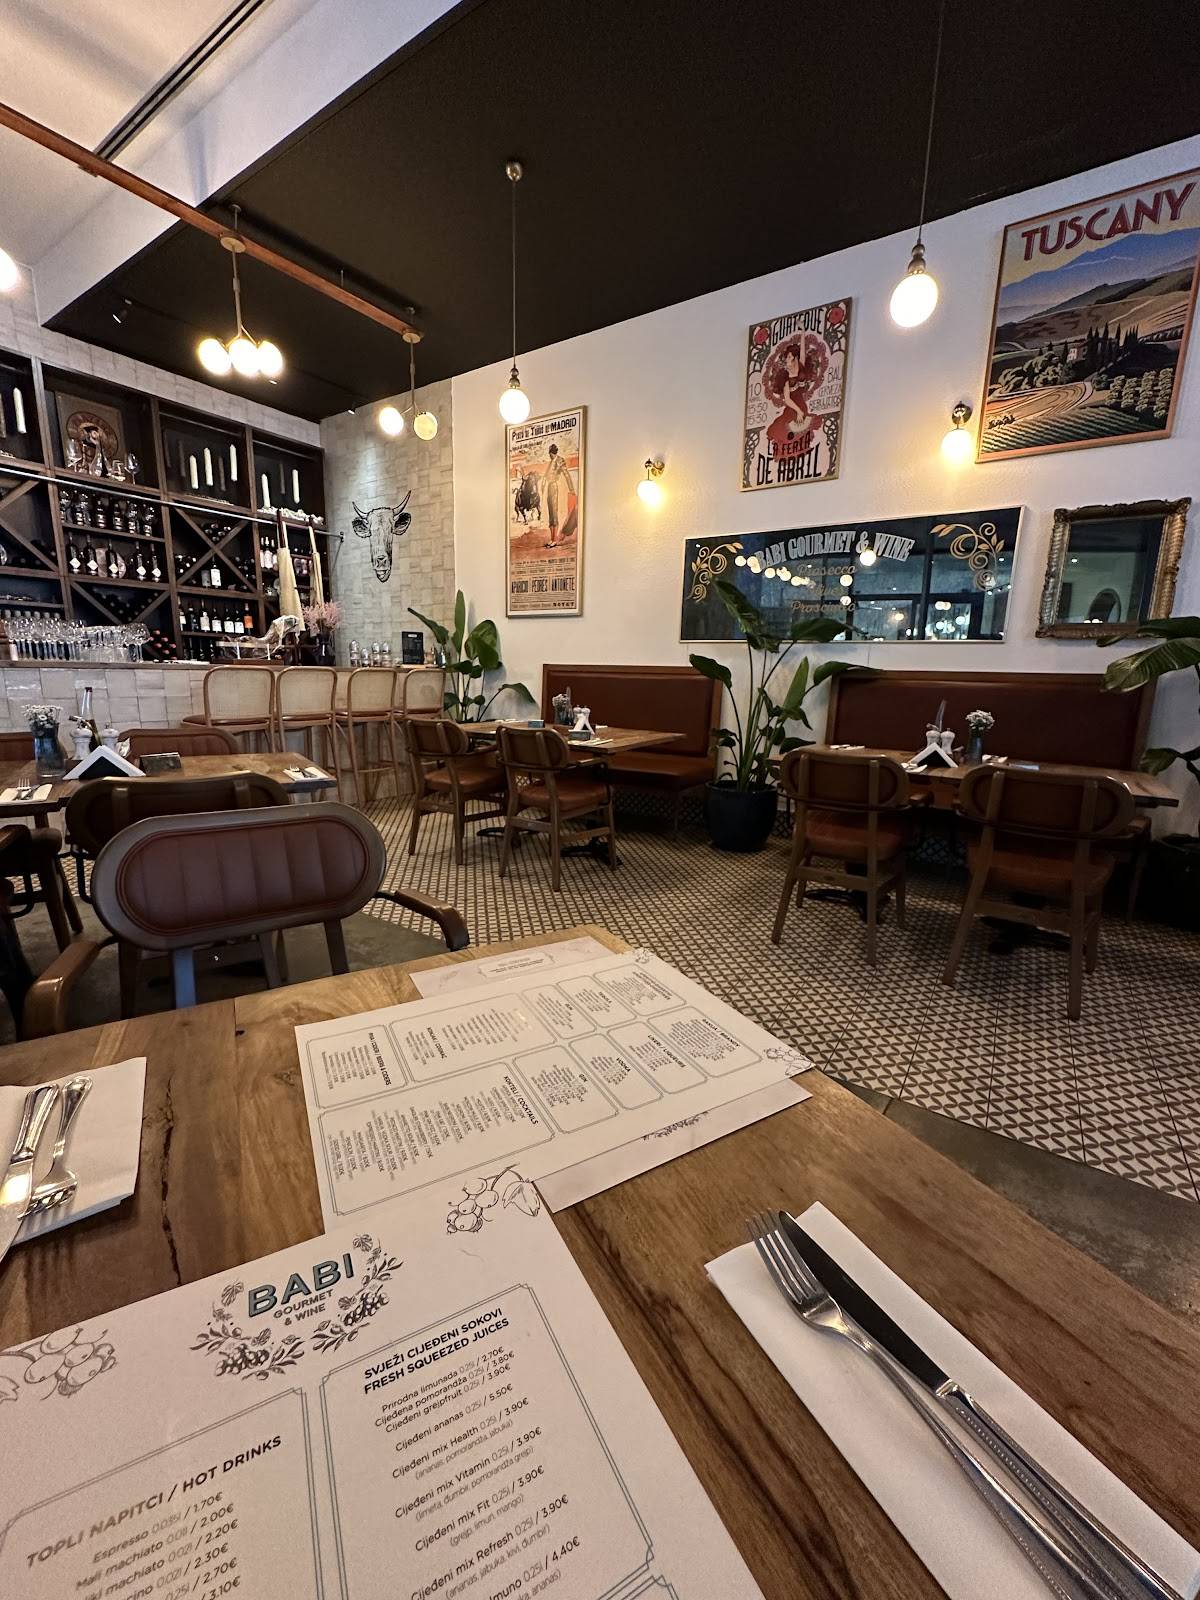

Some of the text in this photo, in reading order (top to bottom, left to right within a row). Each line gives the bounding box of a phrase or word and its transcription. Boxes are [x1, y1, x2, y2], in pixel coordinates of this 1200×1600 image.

[1022, 182, 1197, 261] TUSCANY
[550, 417, 577, 431] MADRID
[767, 431, 811, 457] LA FERIA
[757, 442, 822, 485] DE ABRIL
[755, 530, 915, 569] BABI GOURMET & WINE
[503, 1075, 520, 1095] KOKTELI
[517, 1096, 540, 1126] COCKTAILS
[248, 1253, 354, 1318] BABI
[273, 1289, 334, 1319] GOURMET
[284, 1303, 326, 1326] & WINE
[364, 1318, 509, 1394] FRESH SQUEEZED JUICES
[365, 1308, 502, 1379] SVJEŽI CIJEĐENI SOKOVI
[382, 1391, 418, 1413] Prirodna
[421, 1371, 458, 1393] limunada
[477, 1357, 481, 1367] /
[415, 1377, 467, 1408] pomorandža
[487, 1362, 489, 1372] /
[423, 1389, 462, 1415] grejpfruit
[482, 1375, 485, 1384] /
[434, 1411, 463, 1431] ananas
[482, 1395, 486, 1407] /
[489, 1384, 512, 1401] 5.50€
[432, 1443, 448, 1457] mix
[450, 1427, 478, 1447] Health
[499, 1411, 501, 1422] /
[504, 1398, 528, 1416] 3.90€
[437, 1480, 454, 1495] mix
[455, 1458, 490, 1482] Vitamin
[511, 1440, 514, 1453] /
[516, 1427, 541, 1447] 3.90€
[27, 1436, 281, 1568] TOPLI NAPITCI / HOT DRINKS
[92, 1530, 149, 1564] Espresso
[183, 1506, 191, 1520] /
[194, 1492, 222, 1512] 1.70€
[415, 1520, 455, 1551] Cijeđeni
[458, 1509, 475, 1526] mix
[477, 1499, 490, 1513] Fit
[512, 1481, 515, 1494] /
[517, 1465, 544, 1487] 3.90€
[105, 1540, 163, 1577] machiato
[190, 1520, 198, 1536] /
[200, 1503, 233, 1528] 2.00€
[105, 1559, 165, 1596] machiato
[193, 1536, 202, 1552] /
[205, 1519, 239, 1544] 2.20€
[183, 1560, 191, 1576] /
[194, 1542, 228, 1569] 2.30€
[456, 1557, 474, 1575] mix
[476, 1532, 513, 1562] Refresh
[536, 1511, 538, 1525] /
[541, 1494, 568, 1518] 3.90€
[546, 1555, 548, 1570] /
[552, 1536, 580, 1561] 4.40€
[192, 1575, 200, 1592] /
[203, 1557, 237, 1584] 2.70€
